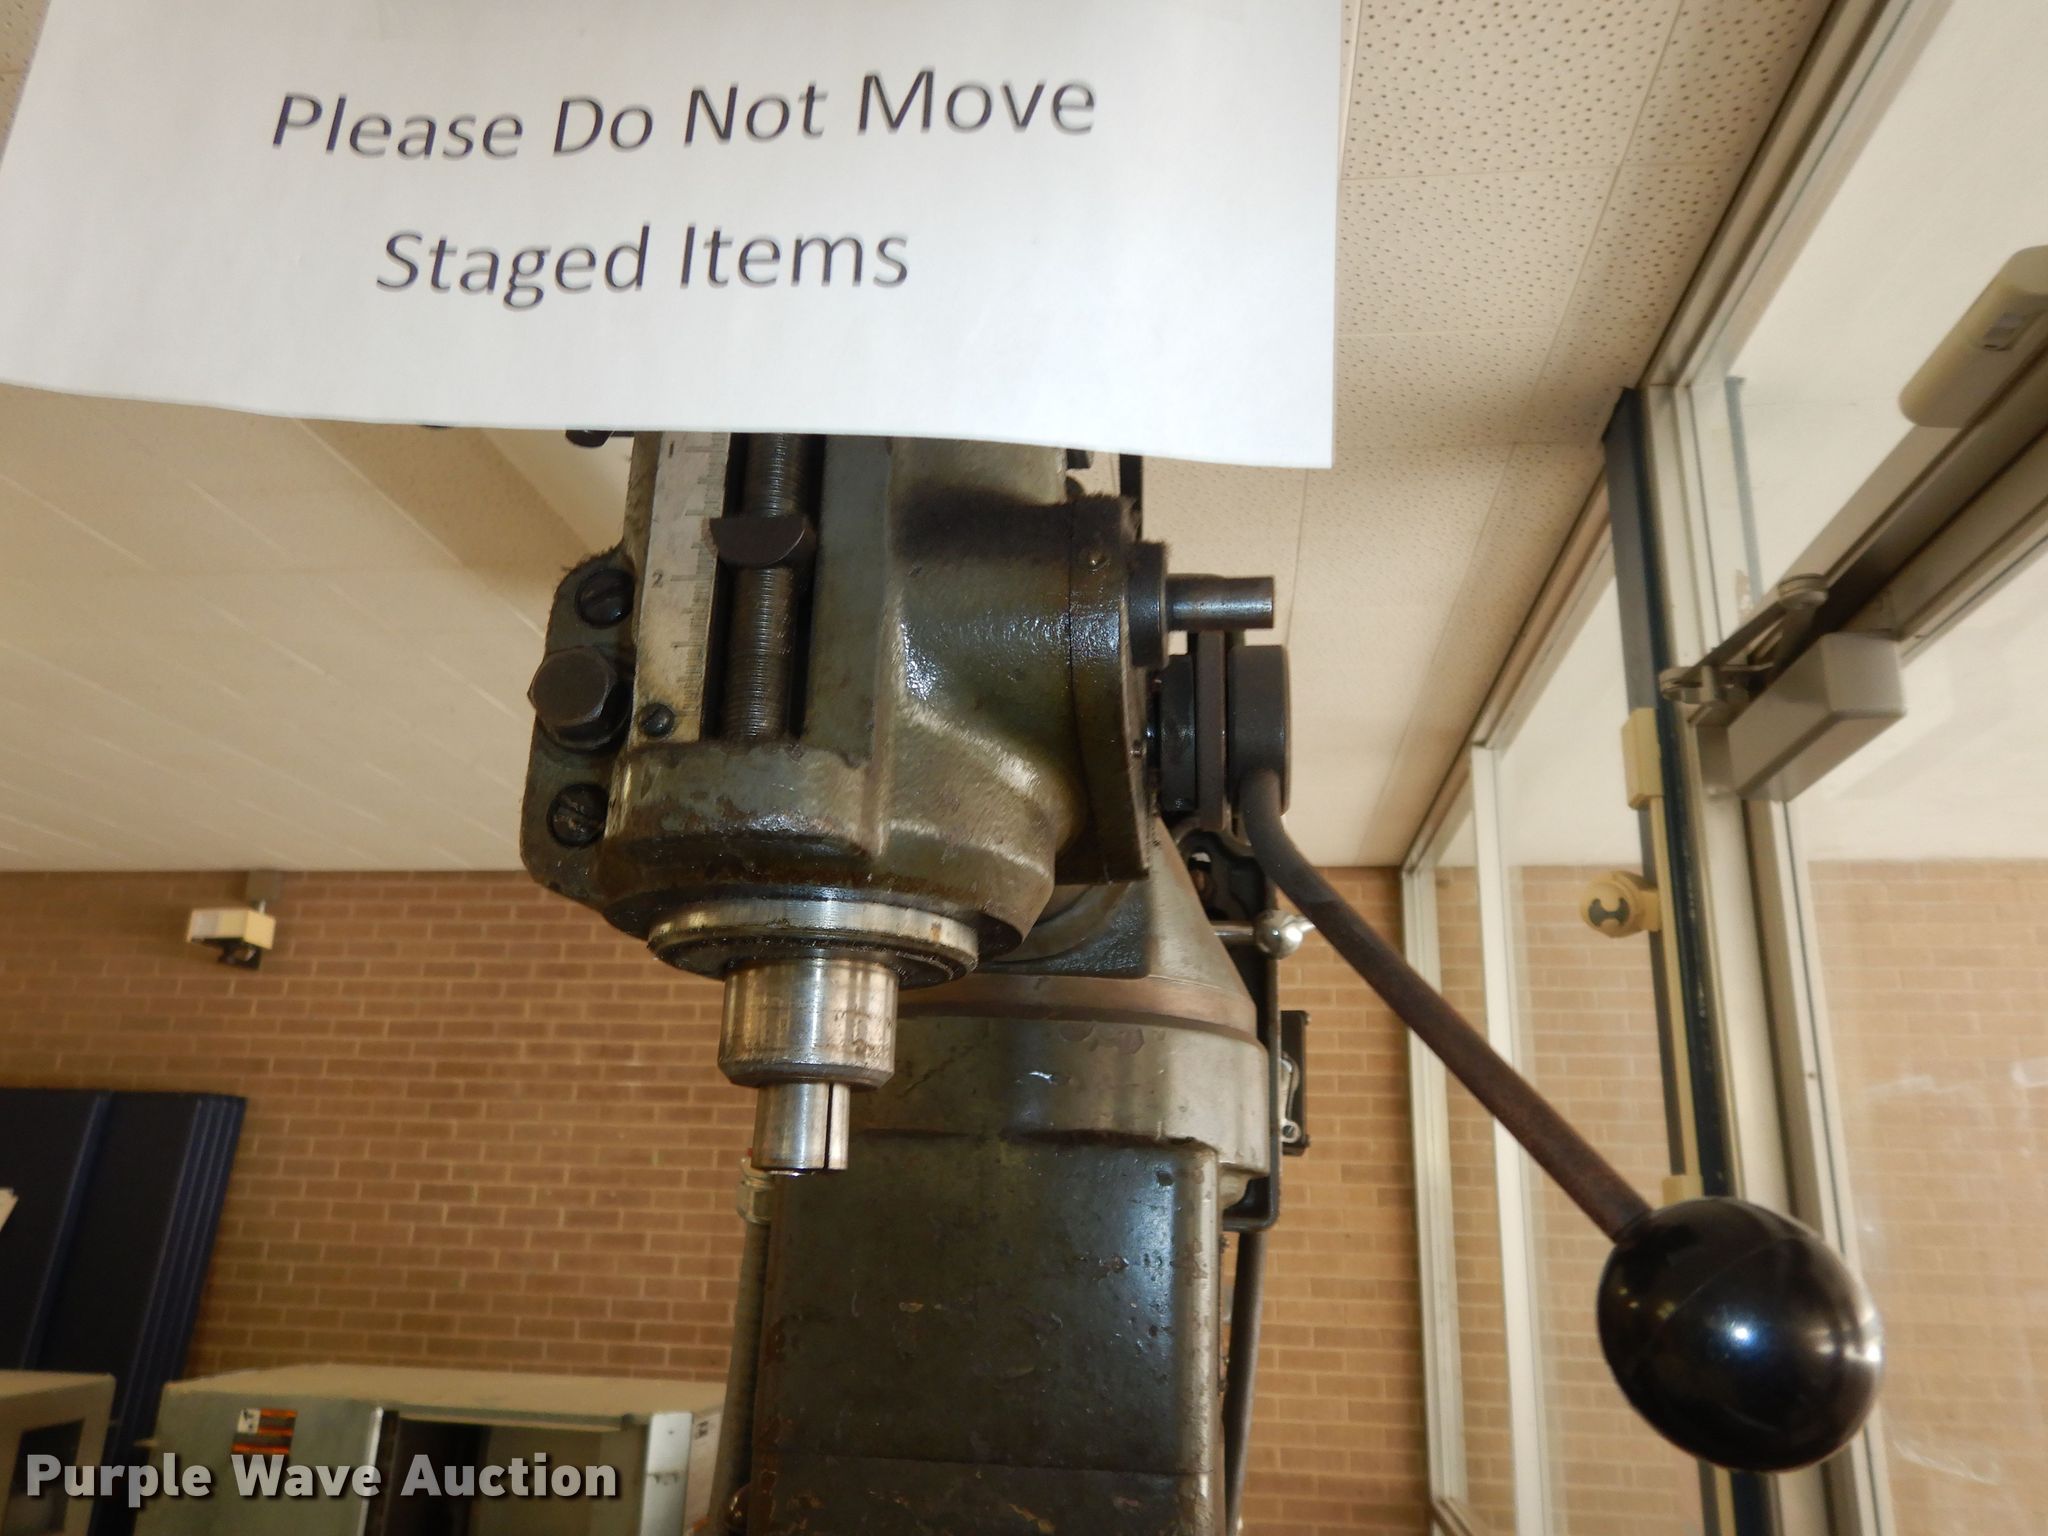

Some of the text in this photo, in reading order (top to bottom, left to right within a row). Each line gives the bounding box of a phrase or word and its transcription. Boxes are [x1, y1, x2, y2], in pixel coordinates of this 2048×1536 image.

[272, 68, 1096, 159] Please Do Not Move
[376, 223, 909, 311] Staged Items
[651, 569, 664, 588] 2
